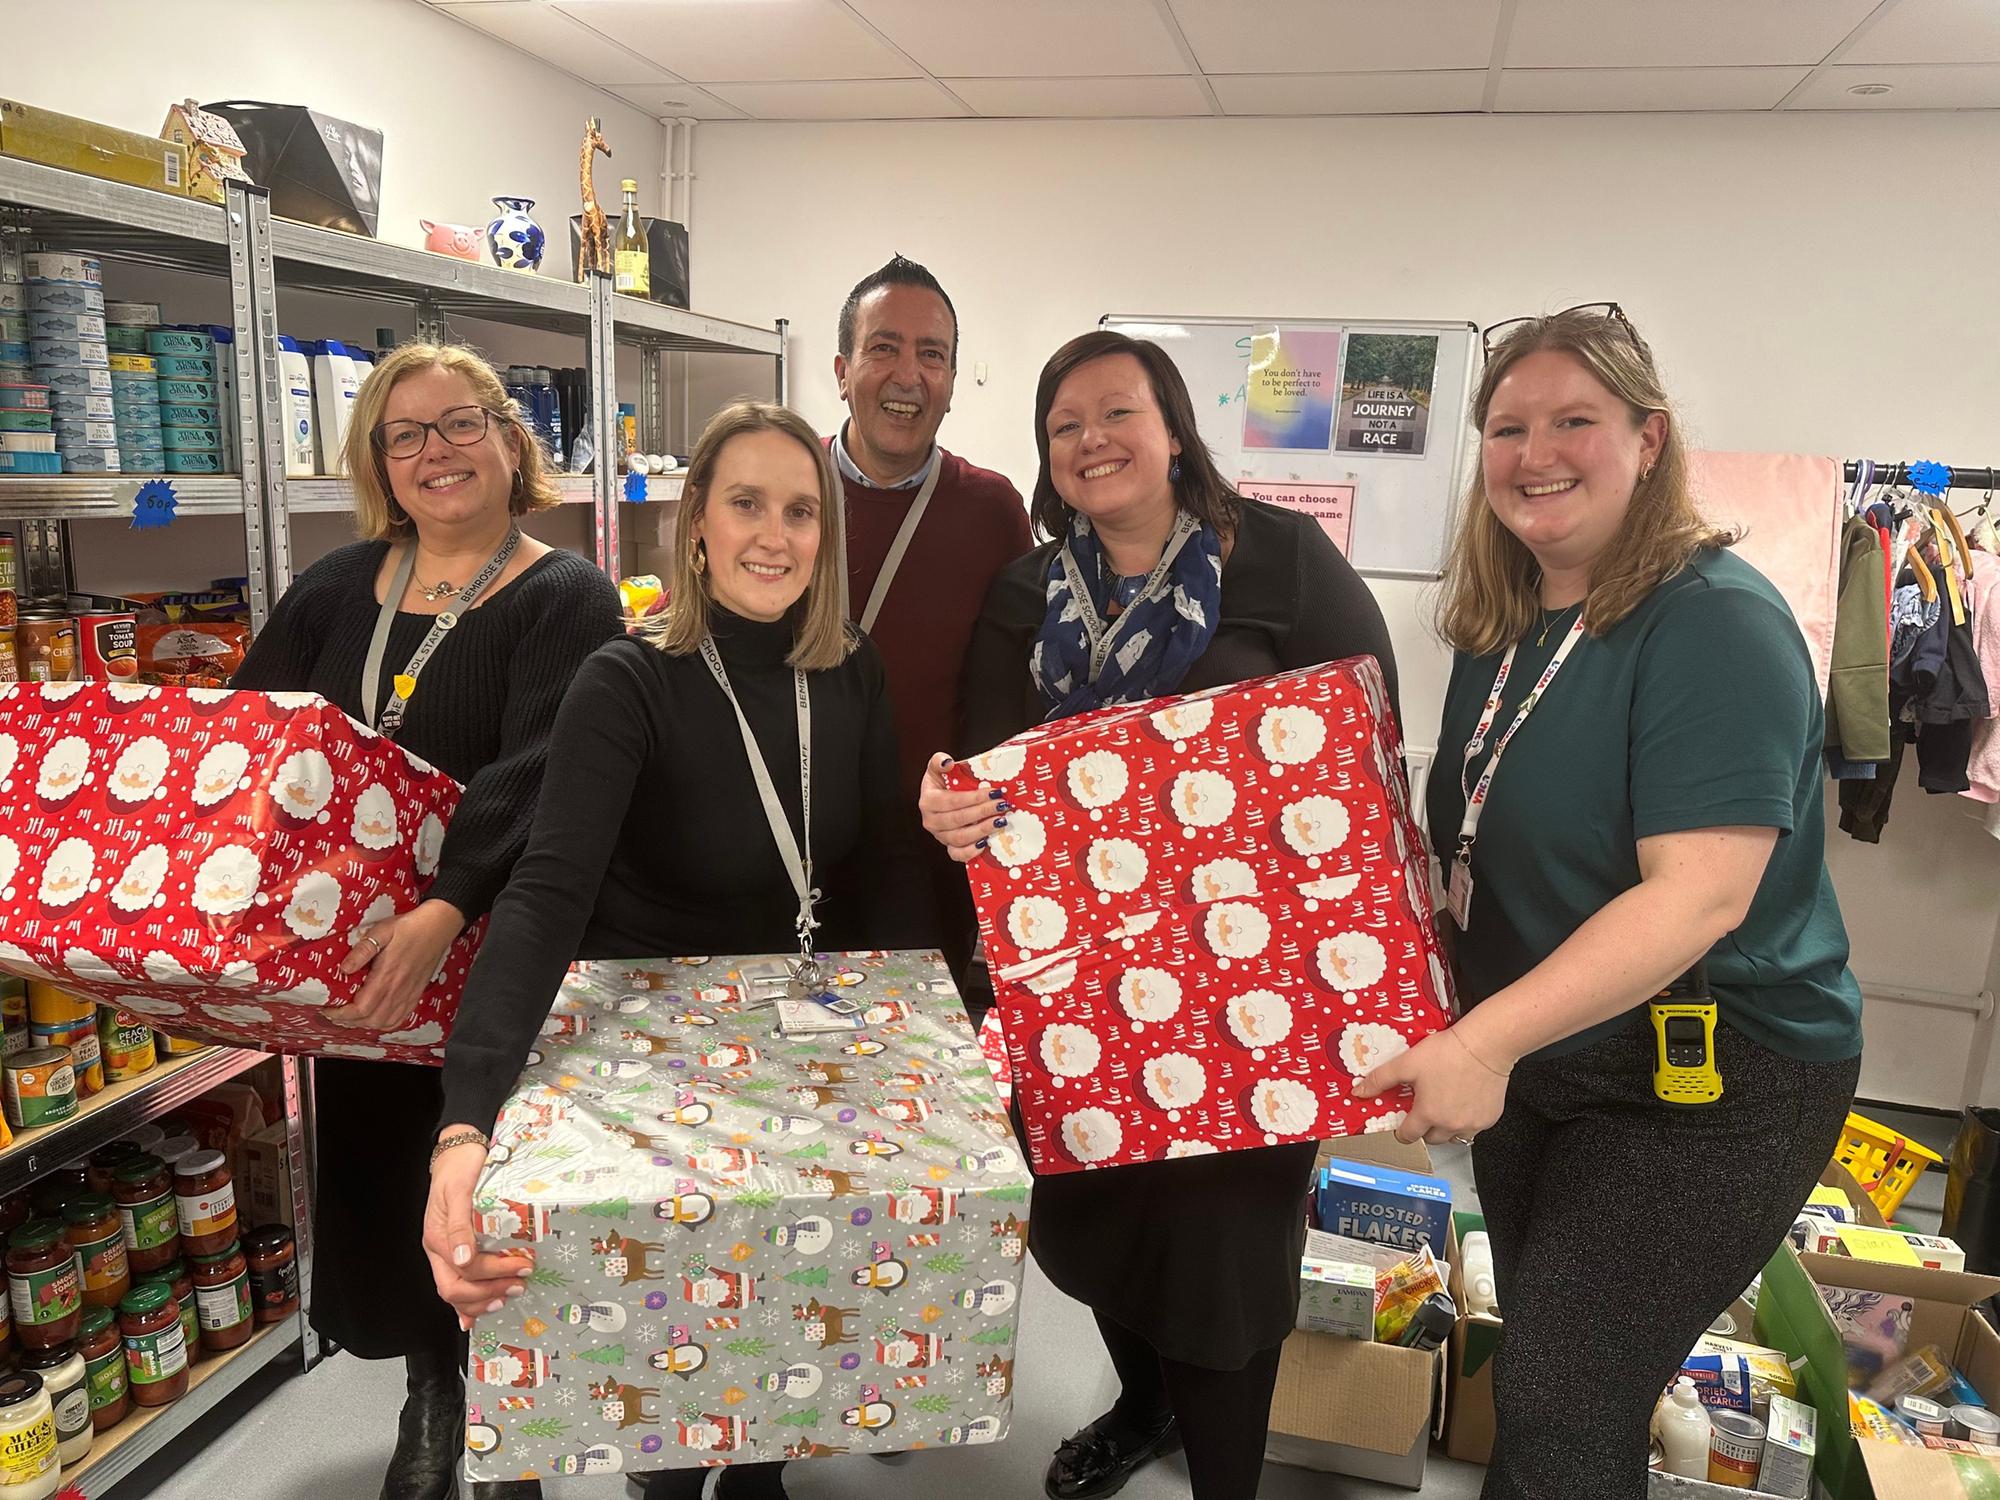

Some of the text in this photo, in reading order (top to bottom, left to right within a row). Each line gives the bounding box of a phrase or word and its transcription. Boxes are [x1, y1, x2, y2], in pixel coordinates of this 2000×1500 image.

[1263, 369, 1321, 378] You don't have
[1272, 378, 1280, 386] be
[1283, 379, 1310, 388] perfect
[1312, 380, 1320, 388] to
[1273, 388, 1308, 396] be loved.
[1387, 391, 1395, 399] IS
[1396, 392, 1404, 400] A
[1353, 403, 1414, 416] JOURNEY
[1369, 420, 1396, 429] NOT A
[1362, 432, 1398, 444] RACE
[1252, 493, 1338, 504] You can choose
[1314, 510, 1342, 518] same
[460, 564, 498, 603] BEMROSE
[1067, 568, 1088, 607] BEMROSE
[113, 640, 134, 648] SOUP
[701, 637, 724, 679] CHOOL
[800, 669, 808, 709] BEMRO
[119, 1026, 148, 1040] PEACH
[120, 1034, 148, 1046] SLICES
[1351, 1202, 1424, 1226] FROSTED
[1338, 1217, 1432, 1248] FLAKES
[1704, 1340, 1733, 1352] HARVEST
[1698, 1386, 1726, 1396] DRIED
[1702, 1396, 1743, 1408] & GARLIC
[10, 1425, 40, 1445] MAC
[1717, 1440, 1756, 1456] STAMFORD
